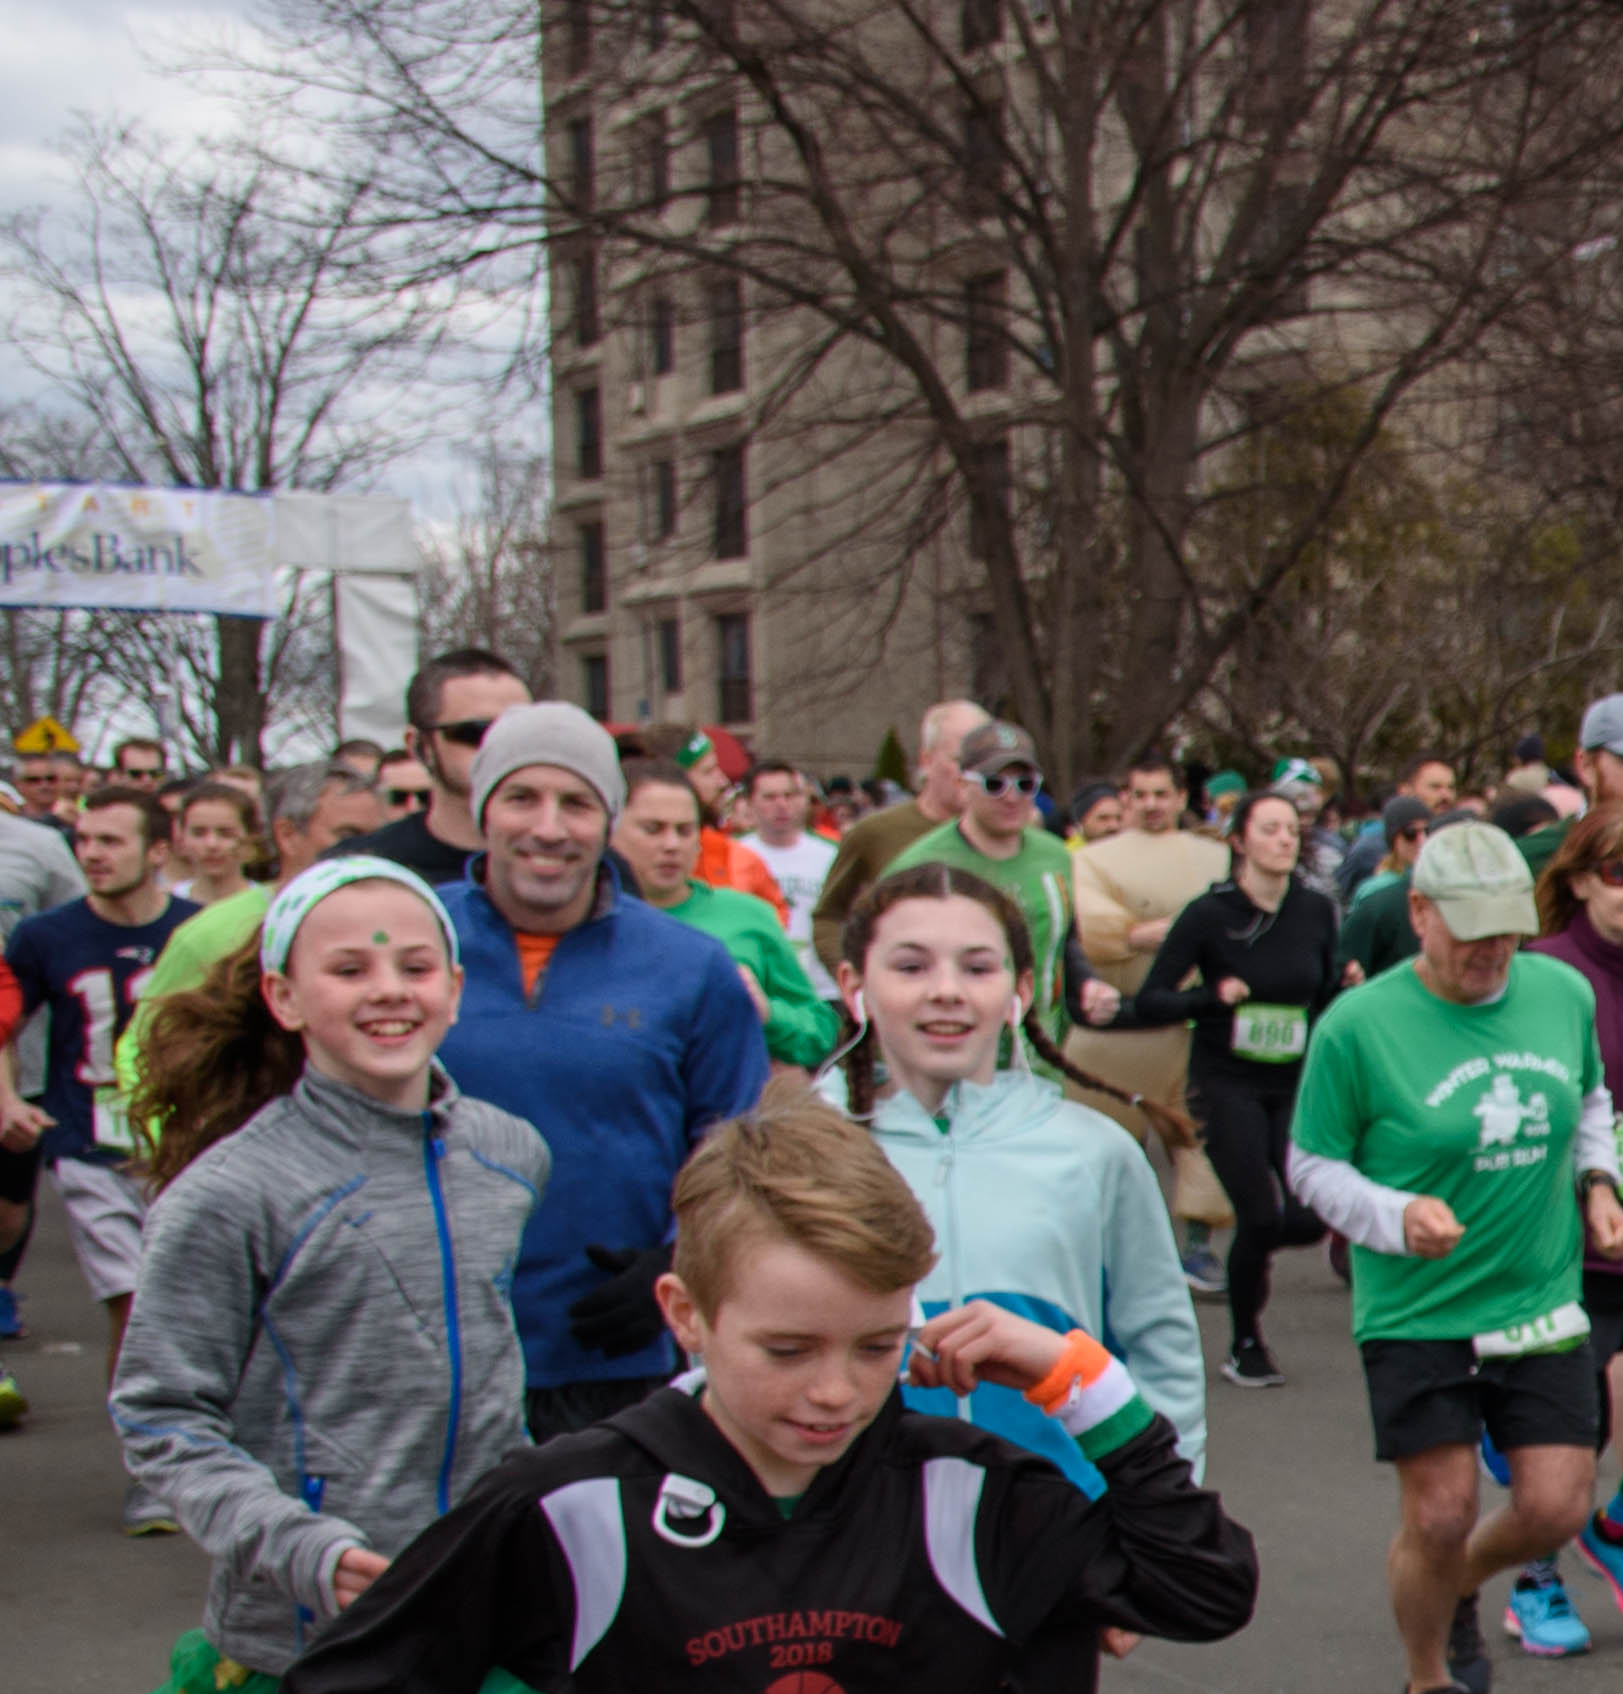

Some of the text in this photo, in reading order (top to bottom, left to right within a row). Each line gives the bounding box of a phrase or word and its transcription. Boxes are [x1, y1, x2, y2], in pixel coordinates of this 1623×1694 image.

[0, 495, 196, 518] TART
[67, 963, 153, 1086] 1
[686, 1610, 904, 1668] SOUTHAMPTON
[769, 1641, 834, 1670] 2018
